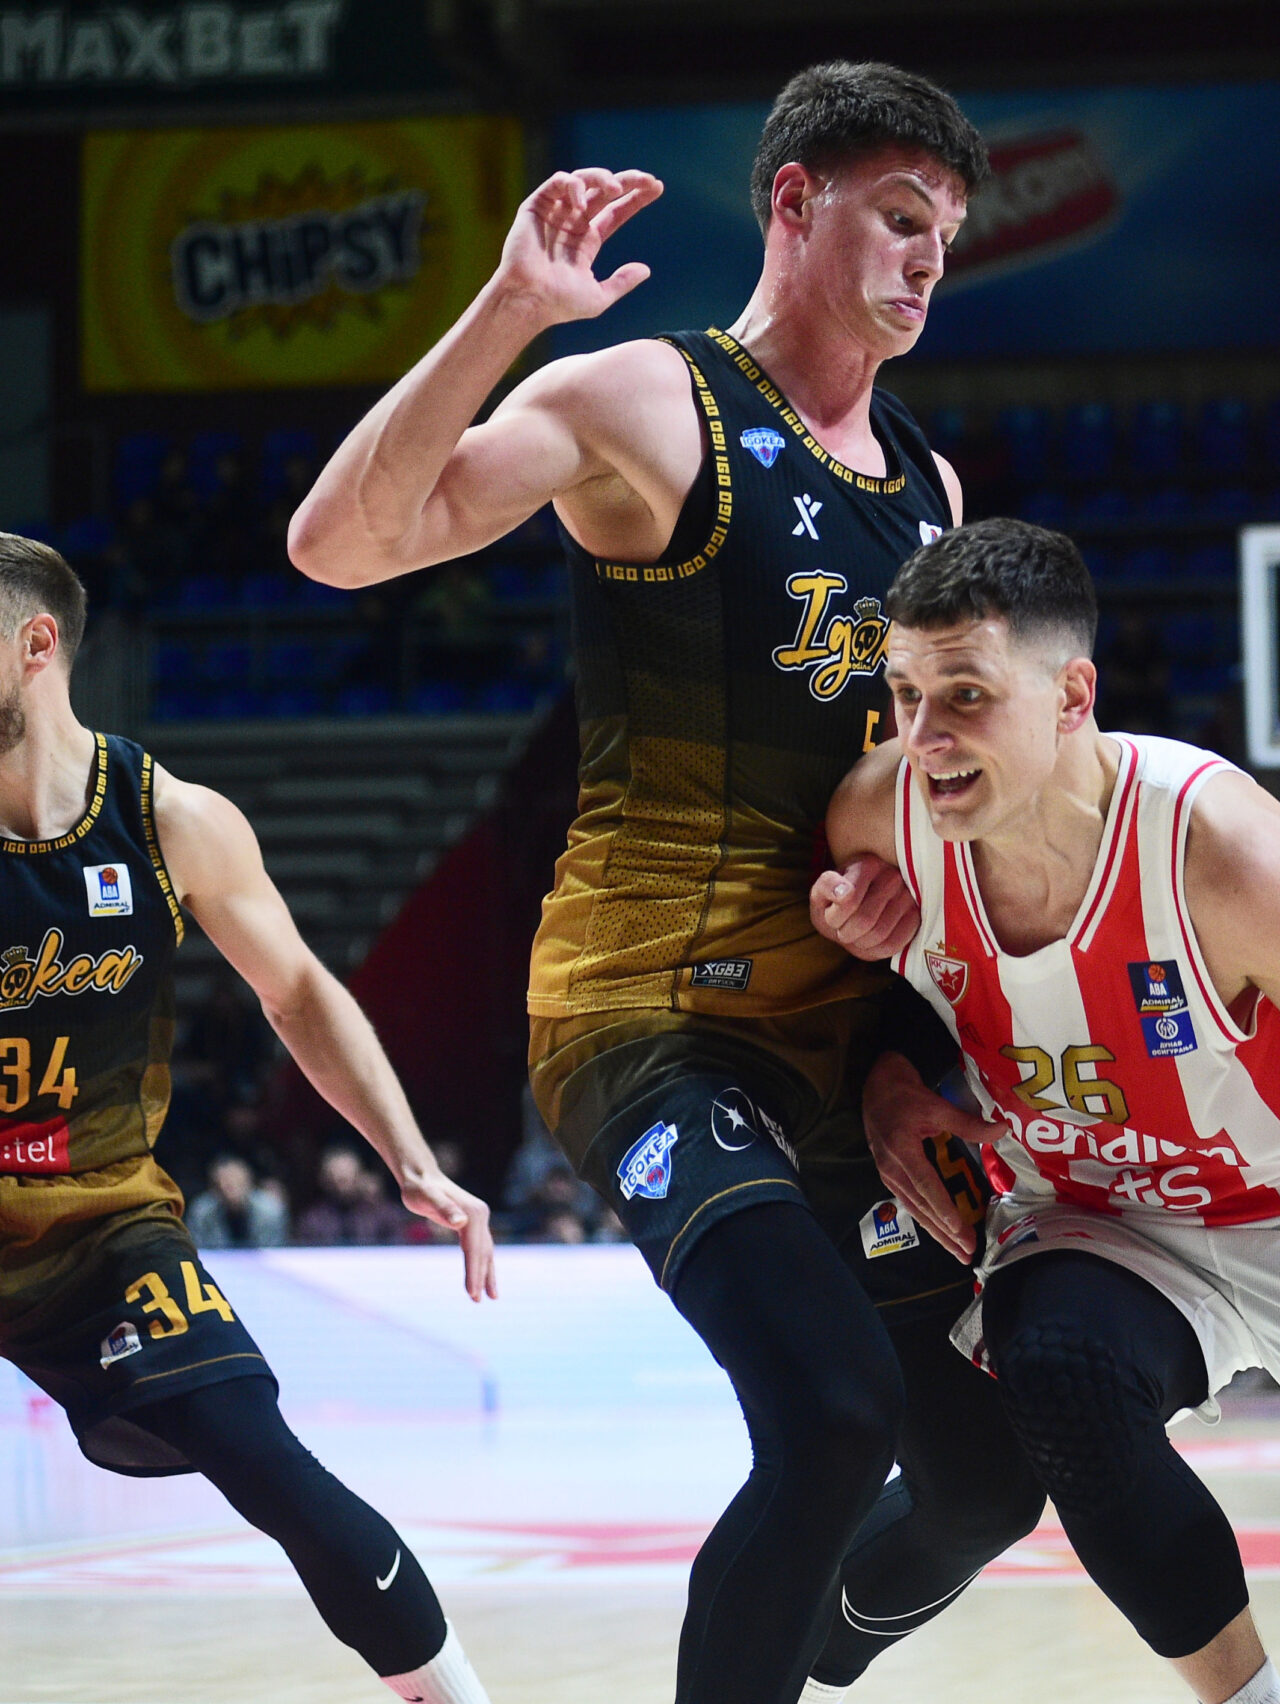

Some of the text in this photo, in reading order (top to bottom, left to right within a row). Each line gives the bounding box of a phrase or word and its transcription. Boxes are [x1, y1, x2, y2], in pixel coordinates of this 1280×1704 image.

[1141, 995, 1184, 1006] ADMIRAL
[1149, 982, 1167, 996] ABA
[0, 1035, 79, 1114] 34
[1000, 1044, 1130, 1125] 26
[623, 1131, 675, 1194] IGOKEA
[870, 1232, 916, 1252] ADMIRAL
[126, 1261, 236, 1340] 34
